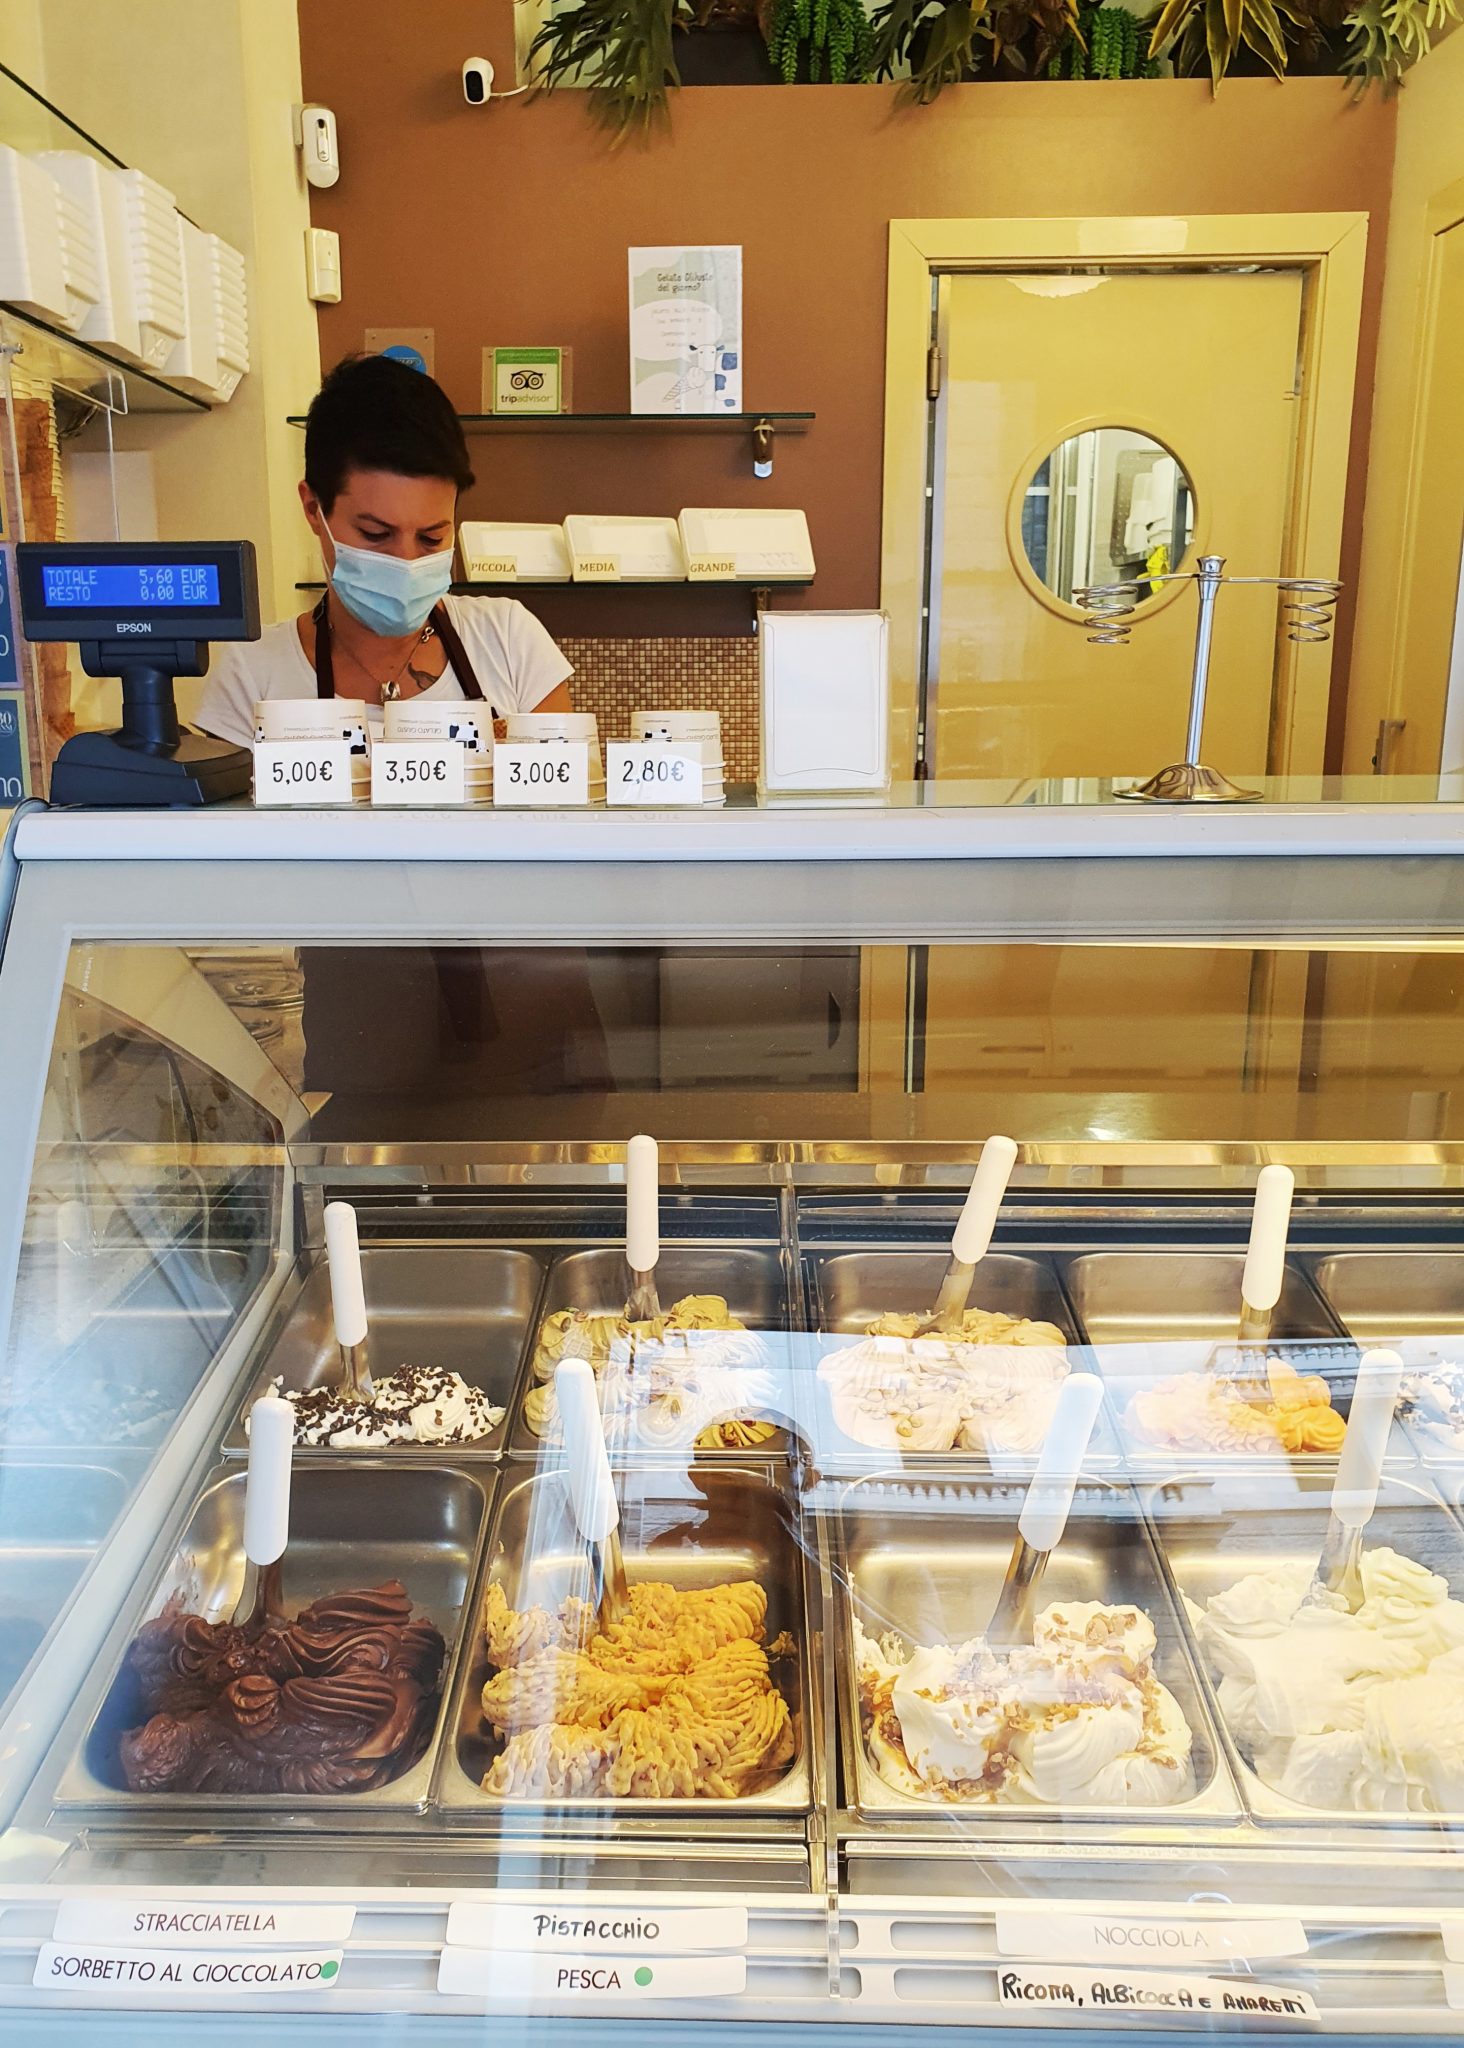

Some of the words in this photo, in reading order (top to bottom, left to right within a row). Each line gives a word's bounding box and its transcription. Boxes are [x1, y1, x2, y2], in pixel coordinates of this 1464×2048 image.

[501, 394, 550, 404] tripadvisor
[47, 569, 98, 585] TOTALE
[139, 568, 173, 585] 5,60
[181, 568, 207, 585] EUR
[470, 561, 516, 573] PICCOLA
[579, 561, 616, 573] MEDIA
[689, 561, 736, 574] GRANDE
[48, 586, 91, 601] RESTO
[140, 585, 175, 601] 0,00
[182, 585, 208, 600] EUR
[116, 623, 152, 633] EPSON
[272, 760, 333, 785] 5,00€
[385, 760, 446, 784] 3,50€
[509, 762, 570, 786] 3,00€
[622, 760, 684, 784] 2,80€
[134, 1913, 276, 1932] STRACCIATELLA
[1094, 1926, 1209, 1948] NOCCIOLA
[51, 1956, 155, 1981] SORBETTO
[160, 1963, 183, 1982] AL
[193, 1962, 322, 1983] CIOCCOLATO
[557, 1969, 621, 1989] PESCA
